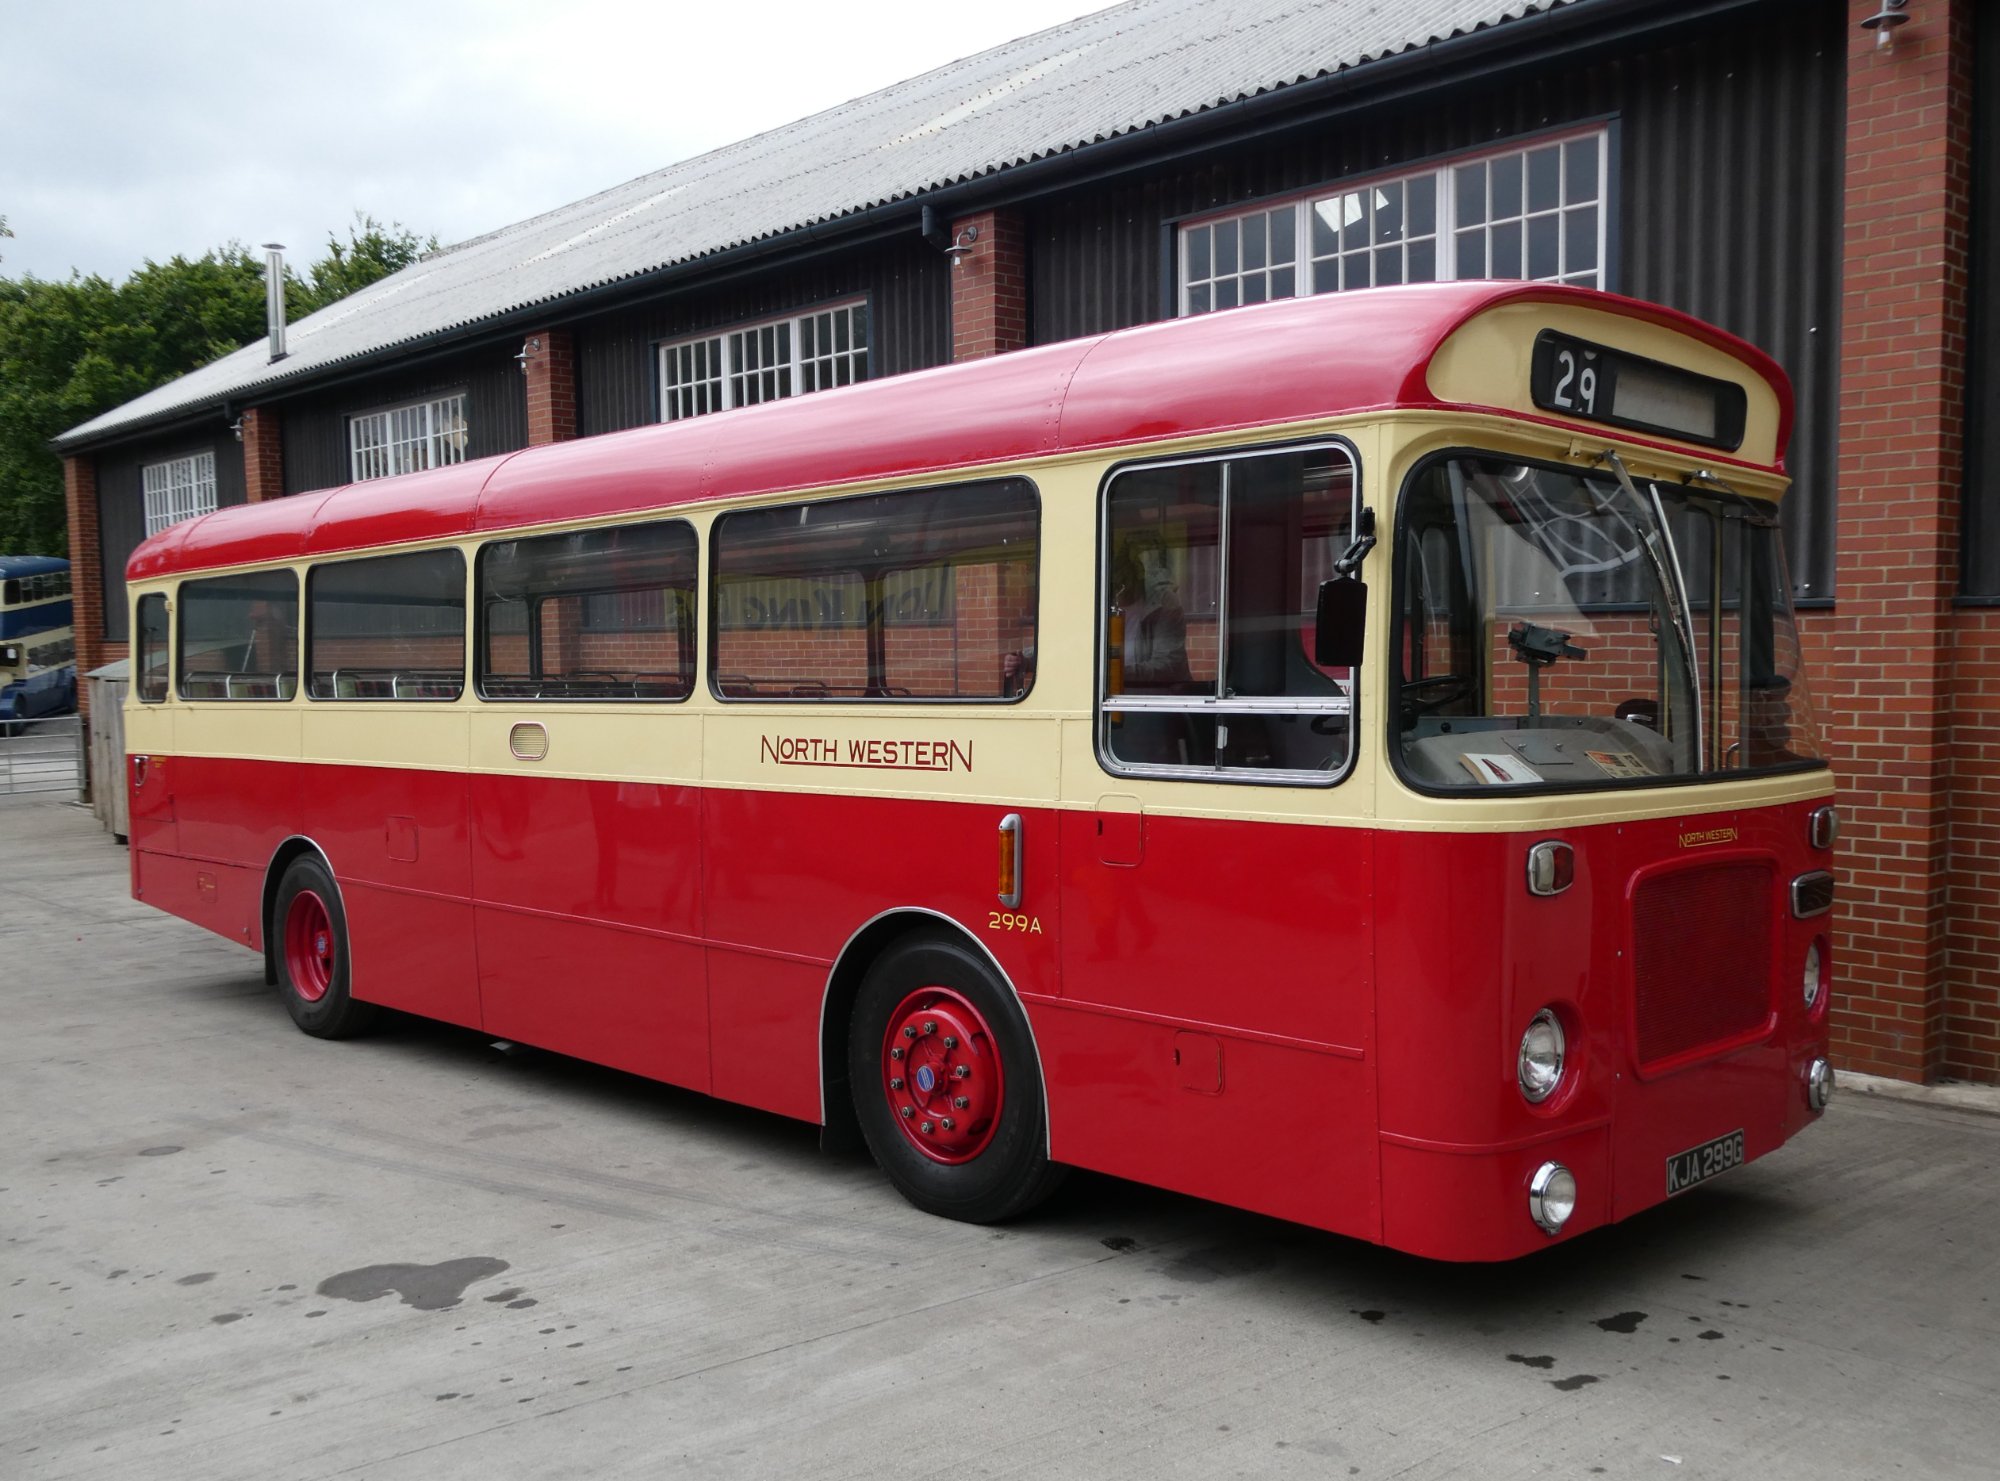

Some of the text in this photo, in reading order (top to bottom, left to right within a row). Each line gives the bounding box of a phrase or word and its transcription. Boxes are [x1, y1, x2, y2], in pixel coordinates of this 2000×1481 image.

[1554, 350, 1596, 415] 29
[761, 735, 973, 772] NORTH WESTERN
[1679, 827, 1738, 848] NORTH WESTERN
[988, 911, 1042, 935] 299A
[1669, 1135, 1743, 1192] KJA 299G
